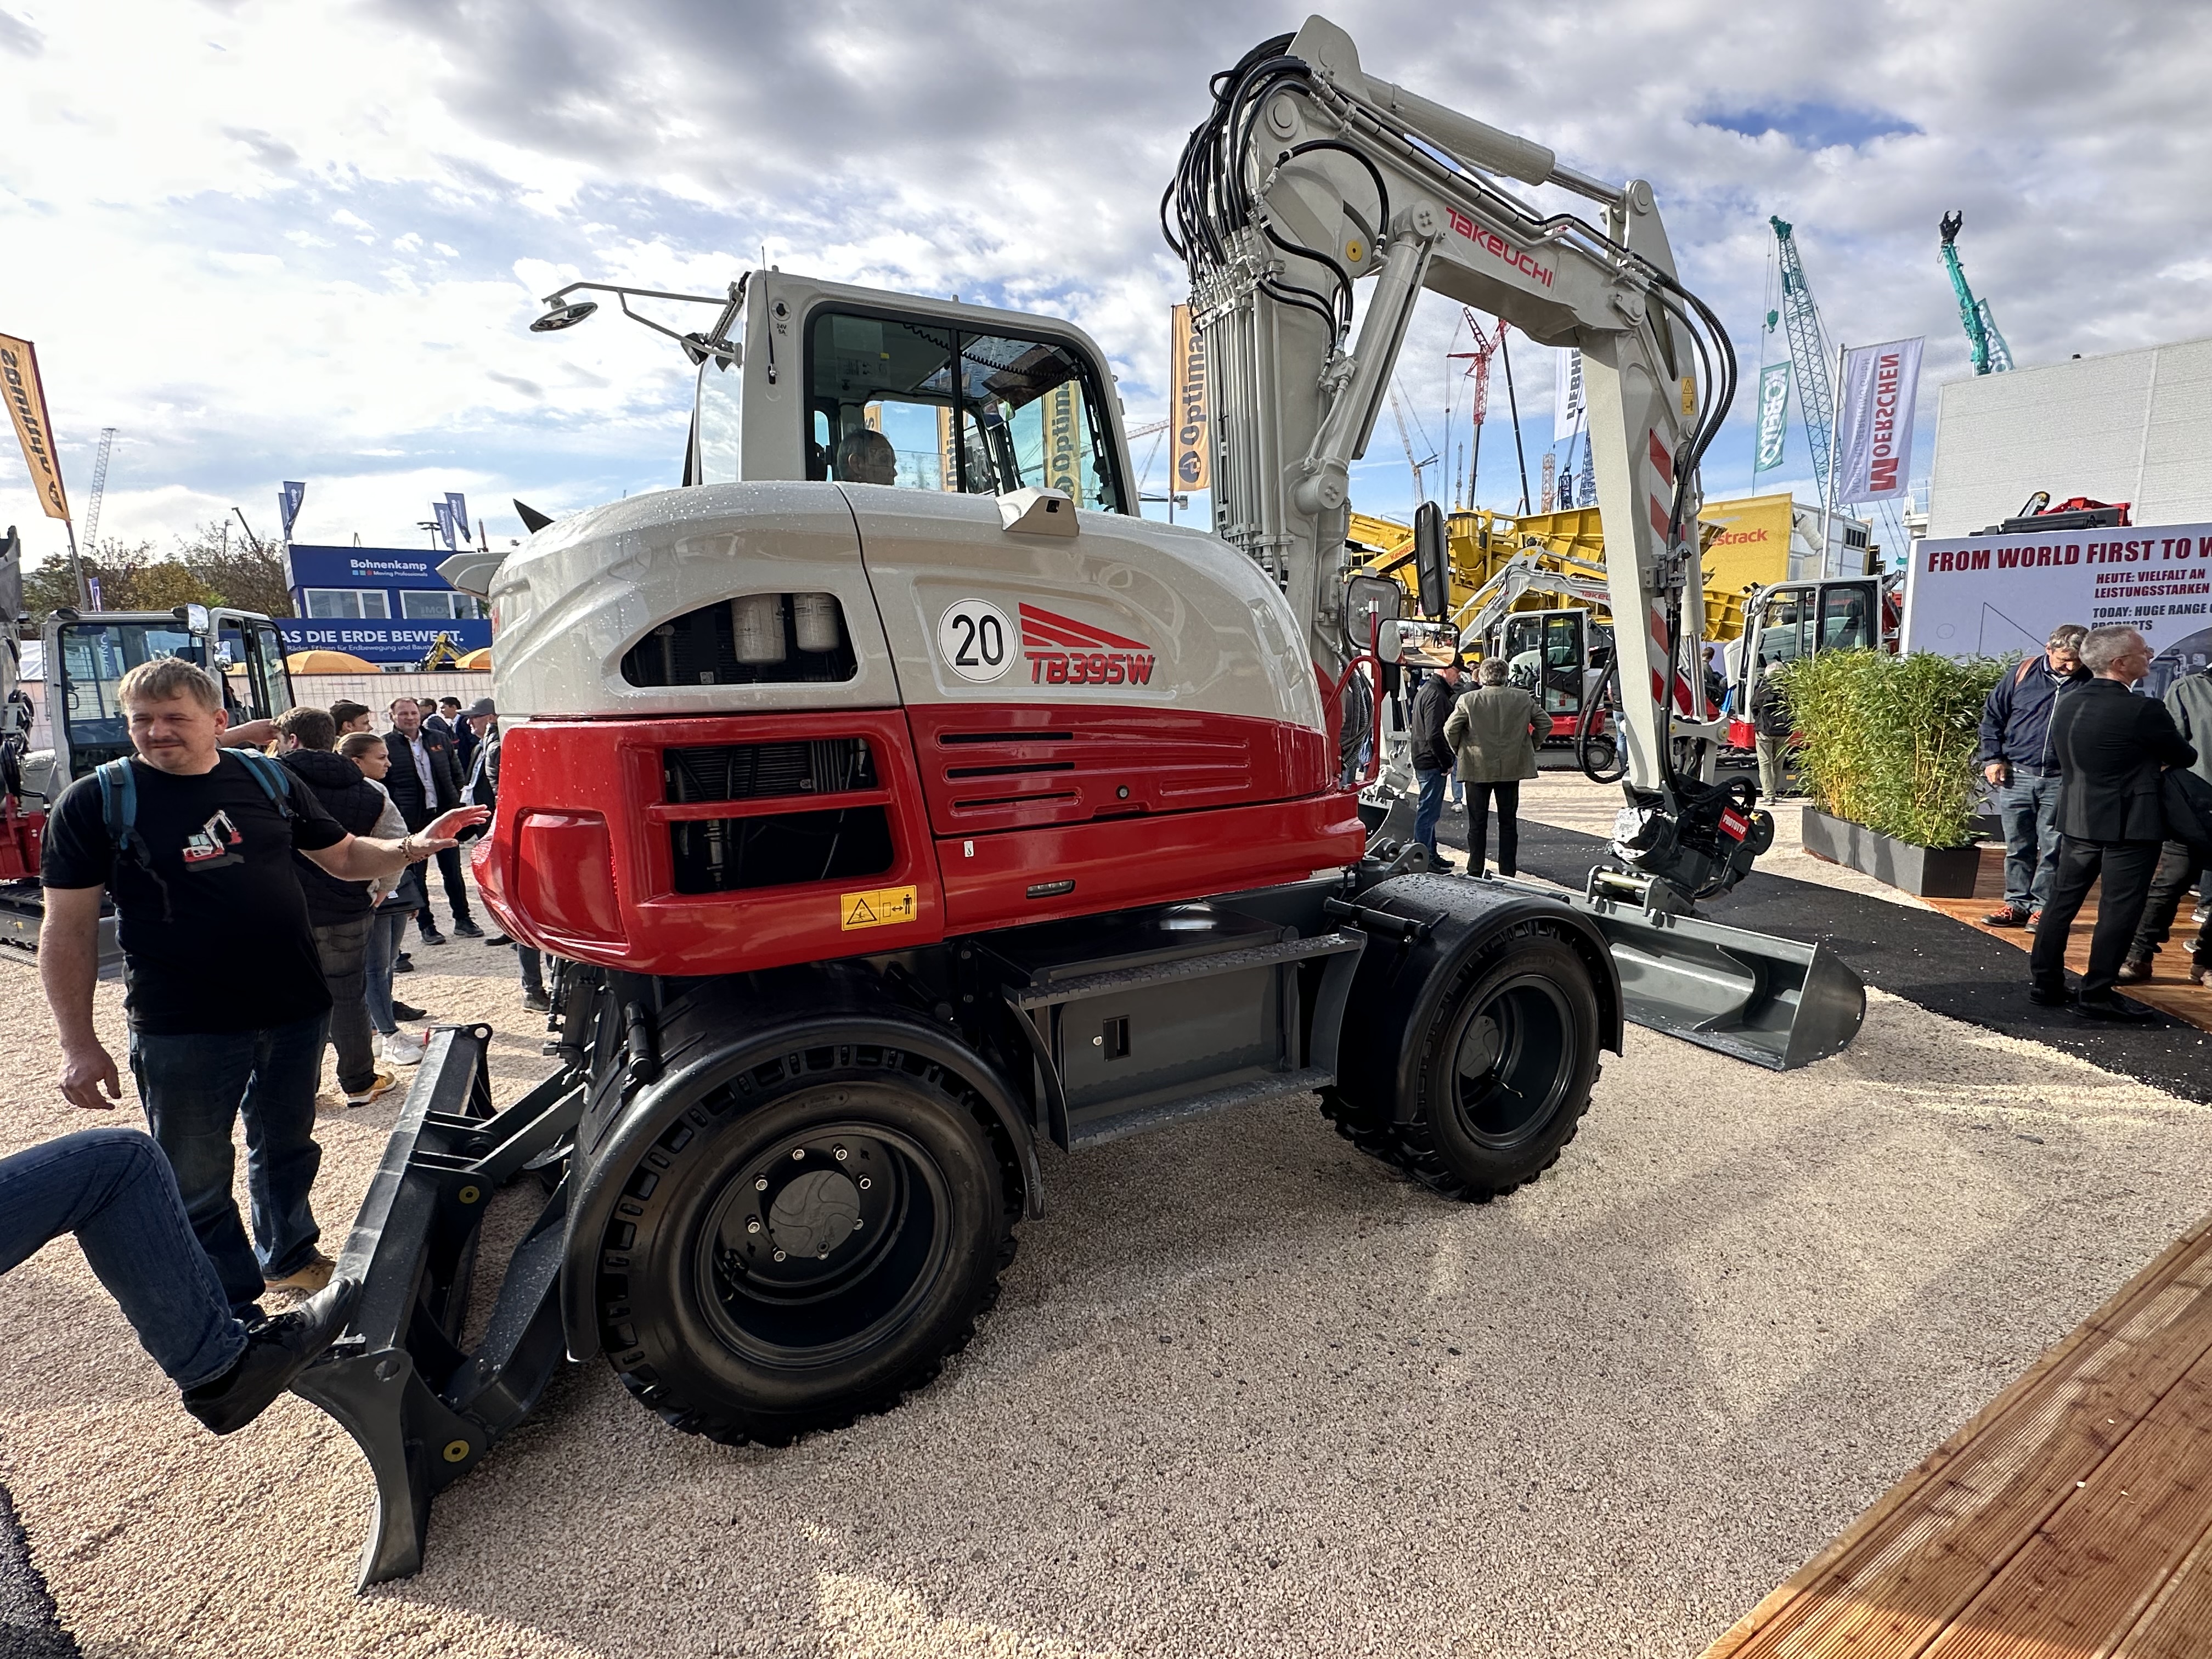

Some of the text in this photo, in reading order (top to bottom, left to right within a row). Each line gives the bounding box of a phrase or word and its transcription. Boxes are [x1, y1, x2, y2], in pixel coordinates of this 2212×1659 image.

[1712, 528, 1769, 545] strack
[1928, 549, 1990, 572] FROM
[1997, 545, 2080, 568] WORLD
[2086, 540, 2154, 564] FIRST
[2161, 538, 2191, 560] TO
[350, 559, 427, 571] Bohnenkamp
[2096, 568, 2205, 584] HEUTE: VIELFALT AN
[2094, 583, 2210, 599] LEISTUNGSSTARKEN
[2093, 606, 2132, 618] TODAY:
[2134, 605, 2166, 617] HUGE
[2168, 603, 2207, 615] RANGE
[306, 630, 337, 642] DIE
[341, 630, 388, 642] ERDE
[952, 614, 1004, 666] 20
[1024, 651, 1155, 685] TB395W
